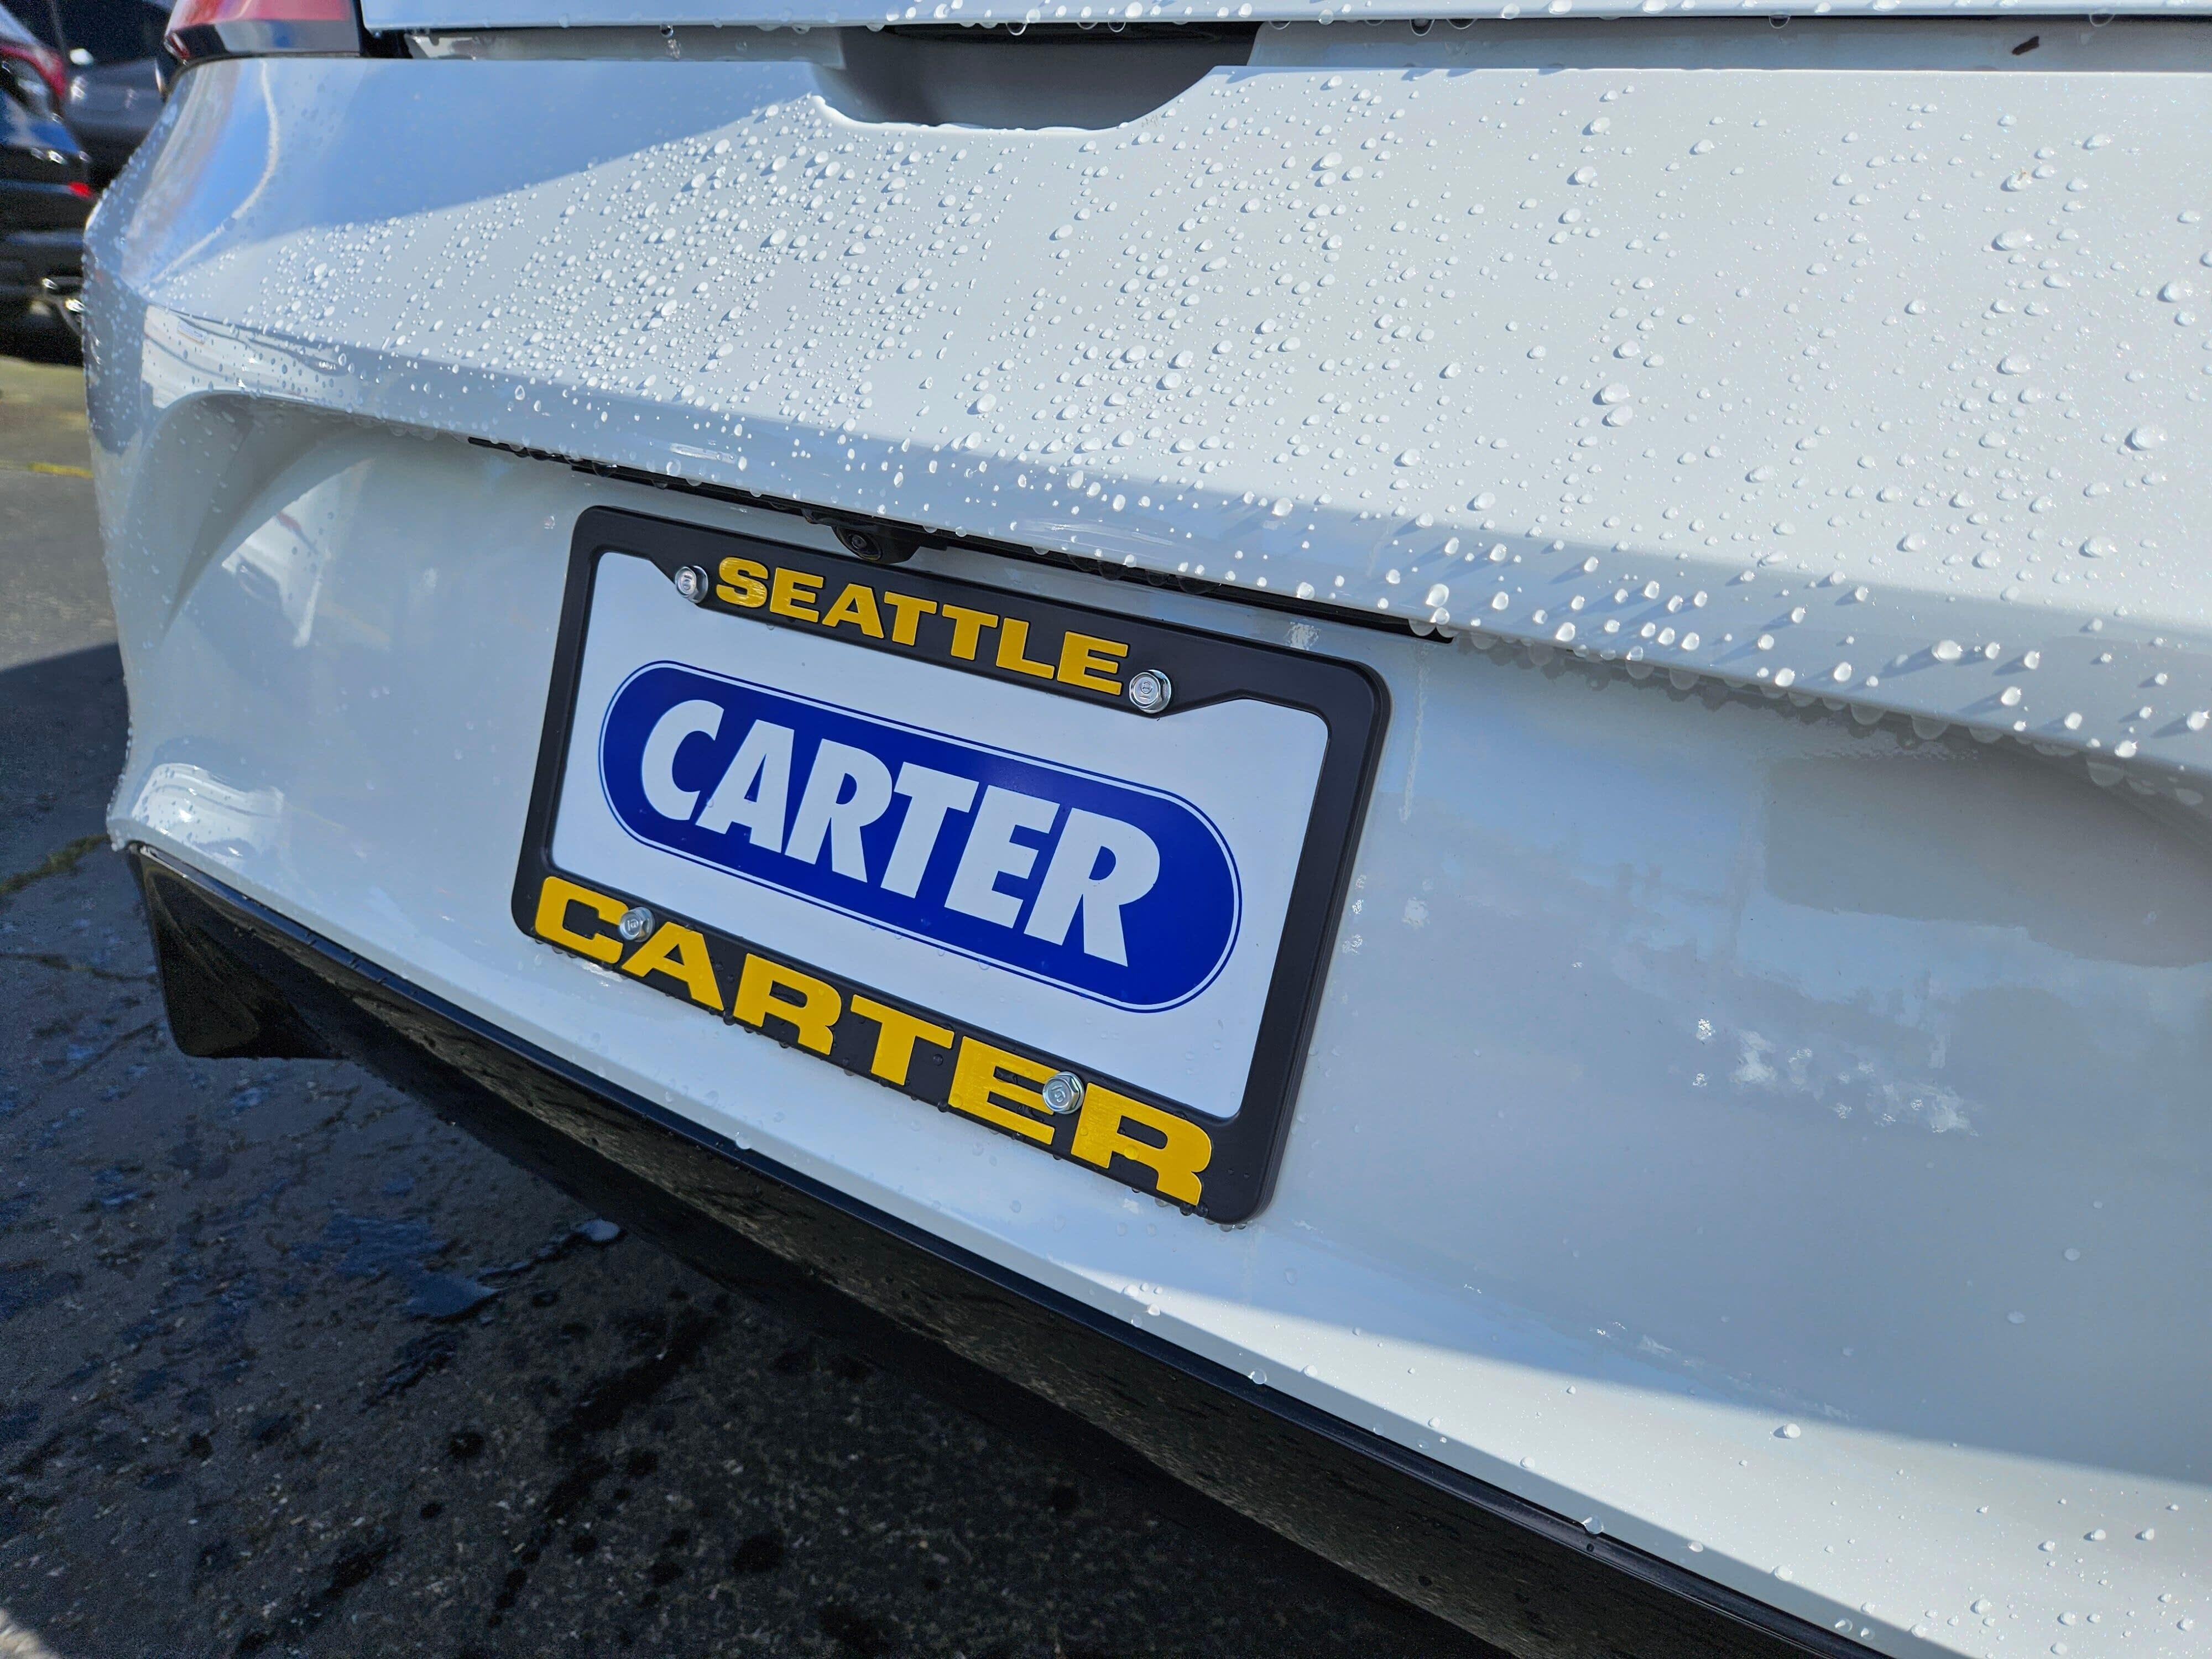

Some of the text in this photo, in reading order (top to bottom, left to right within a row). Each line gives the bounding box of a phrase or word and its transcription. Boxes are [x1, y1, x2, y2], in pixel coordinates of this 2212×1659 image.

[717, 557, 1128, 695] SEATTLE
[640, 699, 1160, 968] CARTER
[534, 876, 1212, 1206] CARTER
